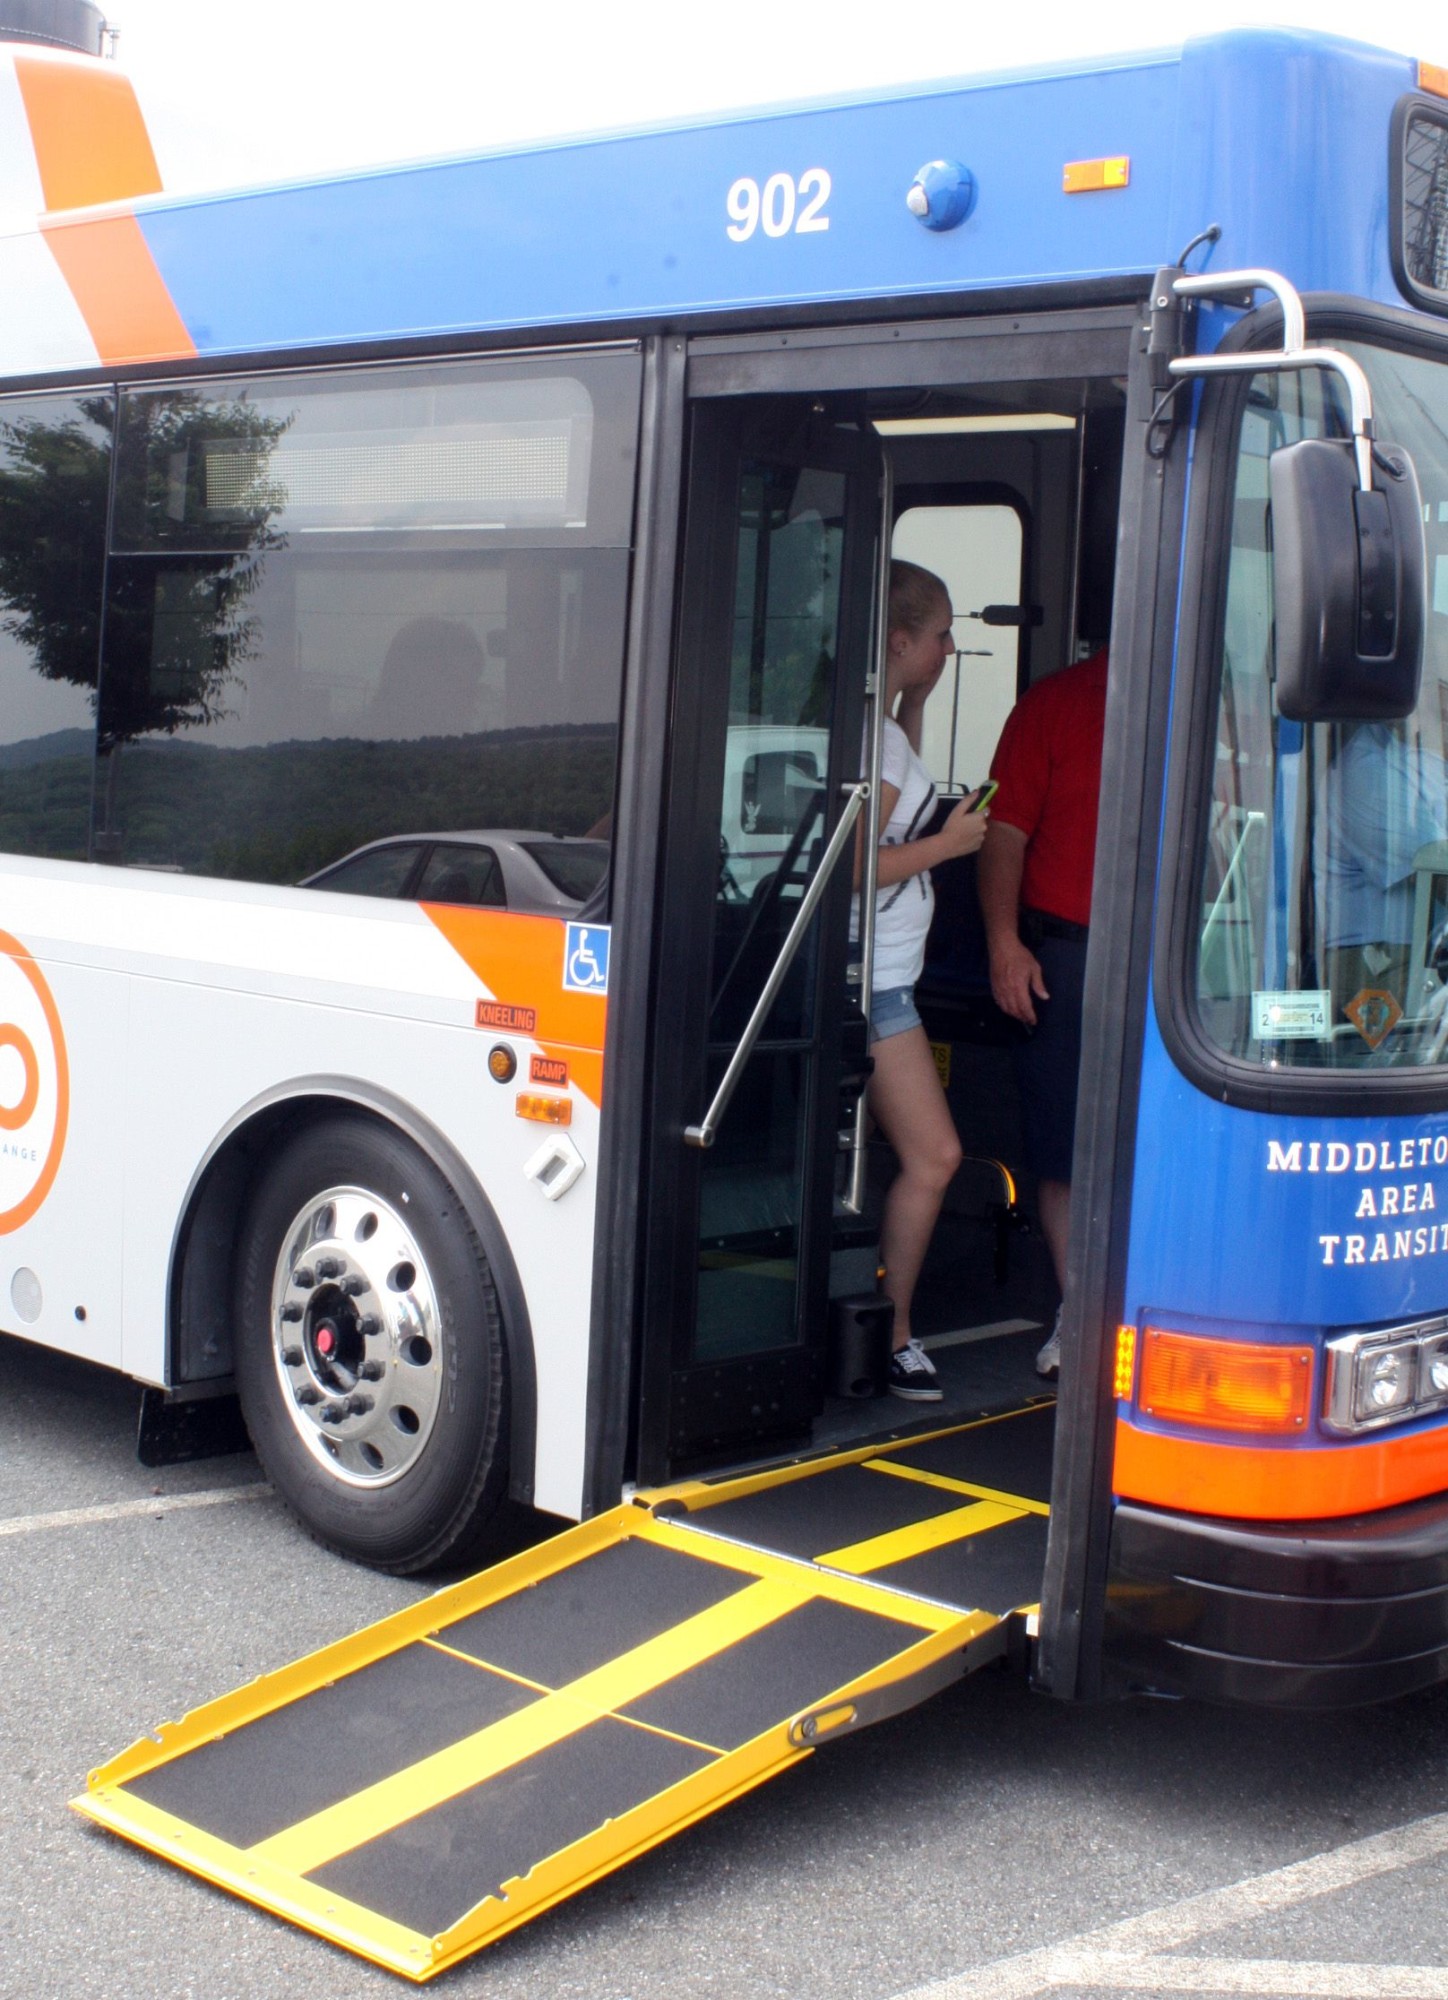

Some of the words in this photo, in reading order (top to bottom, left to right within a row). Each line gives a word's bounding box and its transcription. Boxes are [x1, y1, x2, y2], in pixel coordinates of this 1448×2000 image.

[726, 168, 831, 242] 902
[479, 1003, 534, 1029] KNEELING
[1309, 1012, 1323, 1025] 14
[532, 1058, 566, 1081] RAMP
[1266, 1136, 1448, 1172] MIDDLETO
[1355, 1182, 1436, 1217] AREA
